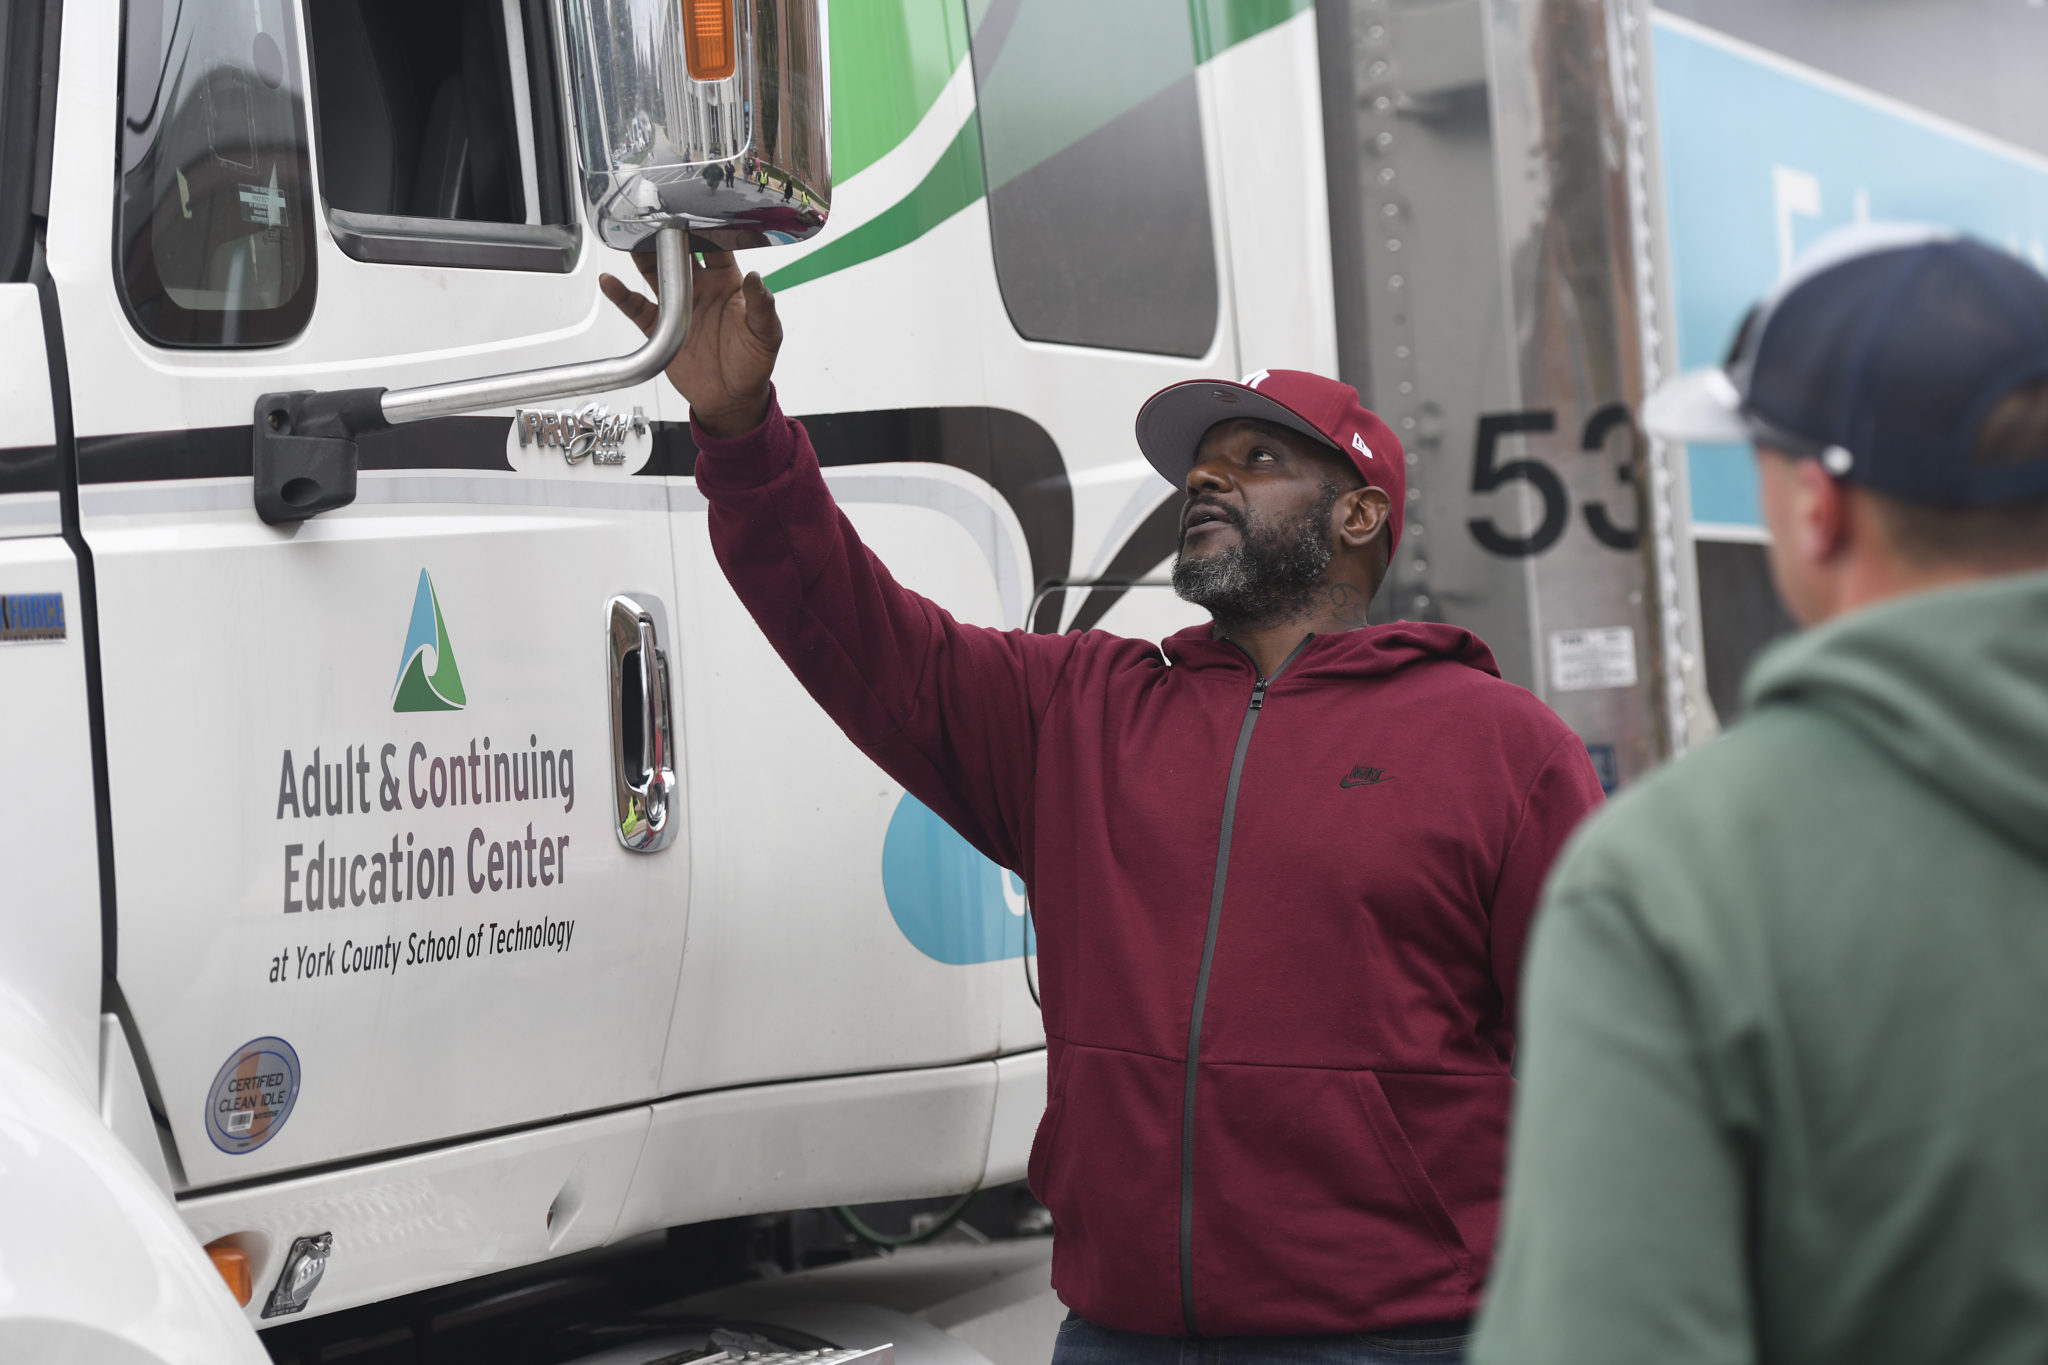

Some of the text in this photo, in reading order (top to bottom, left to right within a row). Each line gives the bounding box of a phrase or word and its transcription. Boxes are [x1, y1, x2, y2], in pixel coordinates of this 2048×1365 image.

[1467, 402, 1648, 560] 53
[276, 733, 575, 820] Adult & Continuing
[1350, 765, 1385, 780] NIKE
[283, 822, 570, 914] Education Center
[268, 916, 575, 983] at York County School of Technology
[219, 1090, 286, 1113] CLEAN IDLE
[228, 1073, 284, 1093] CERTIFIED
